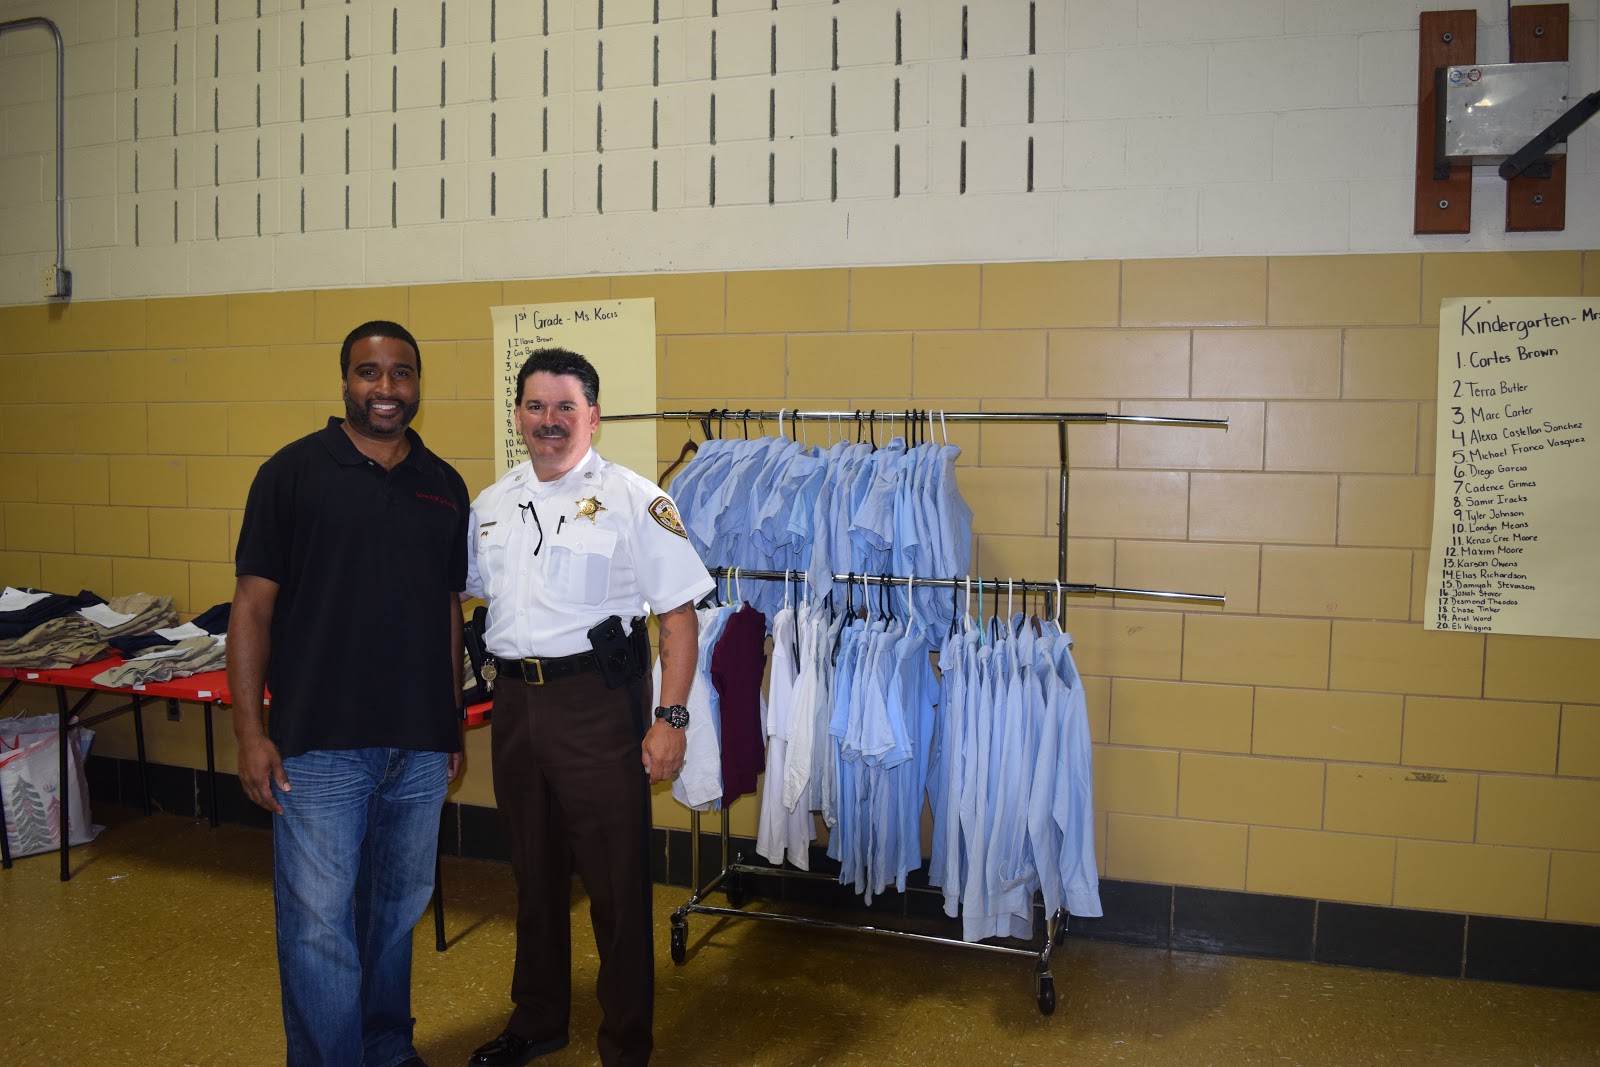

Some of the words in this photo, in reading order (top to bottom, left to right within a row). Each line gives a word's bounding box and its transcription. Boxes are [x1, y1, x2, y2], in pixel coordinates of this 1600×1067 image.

[514, 313, 527, 334] 1st
[533, 310, 563, 330] Grade
[594, 307, 618, 321] Kocis
[536, 335, 553, 343] Brown
[1456, 351, 1466, 369] 1.
[1469, 350, 1512, 368] Cortes
[1516, 345, 1559, 361] Brown
[1465, 381, 1496, 397] Terra
[1500, 380, 1528, 394] Butler
[1451, 406, 1466, 425] 3.
[1471, 406, 1500, 424] Marc
[1504, 403, 1533, 418] Carter
[1470, 429, 1498, 445] Alexa
[1452, 449, 1468, 464] 5.
[1469, 448, 1507, 463] Michael
[1511, 443, 1544, 456] Franco
[1547, 437, 1586, 448] Vasquez
[1467, 463, 1495, 480] Diego
[1497, 464, 1528, 473] Garcia
[1464, 482, 1504, 494] Cadence
[1508, 479, 1537, 489] Grimes
[1453, 496, 1464, 508] 8.
[1465, 496, 1495, 507] Samir
[1497, 494, 1528, 504] Iracks
[1465, 509, 1486, 526] Tyler
[1489, 508, 1525, 519] Johnson
[1452, 523, 1467, 535] 10.
[1469, 522, 1498, 535] Londyn
[1501, 521, 1529, 530] Means
[1452, 536, 1464, 546] 11.
[1466, 535, 1491, 545] Kenzo
[1493, 534, 1510, 542] Cree
[1512, 533, 1538, 542] Moore
[1445, 546, 1459, 557] 12.
[1461, 546, 1495, 556] Maxim
[1497, 545, 1524, 554] Moore
[1443, 557, 1456, 568] 13.
[1457, 558, 1489, 569] Karson
[1491, 557, 1518, 567] Owens
[1455, 570, 1477, 580] Elias
[1480, 568, 1528, 580] Richardson
[1442, 580, 1455, 589] 15.
[1455, 579, 1492, 592] Damiyah
[1451, 589, 1476, 597] Josiah
[1450, 597, 1486, 606] Desmond
[1451, 606, 1474, 614] Chase
[1477, 605, 1501, 613] Tinker
[1437, 613, 1450, 622] 19.
[1451, 622, 1462, 630] Eli
[1464, 622, 1492, 633] Wiggins
